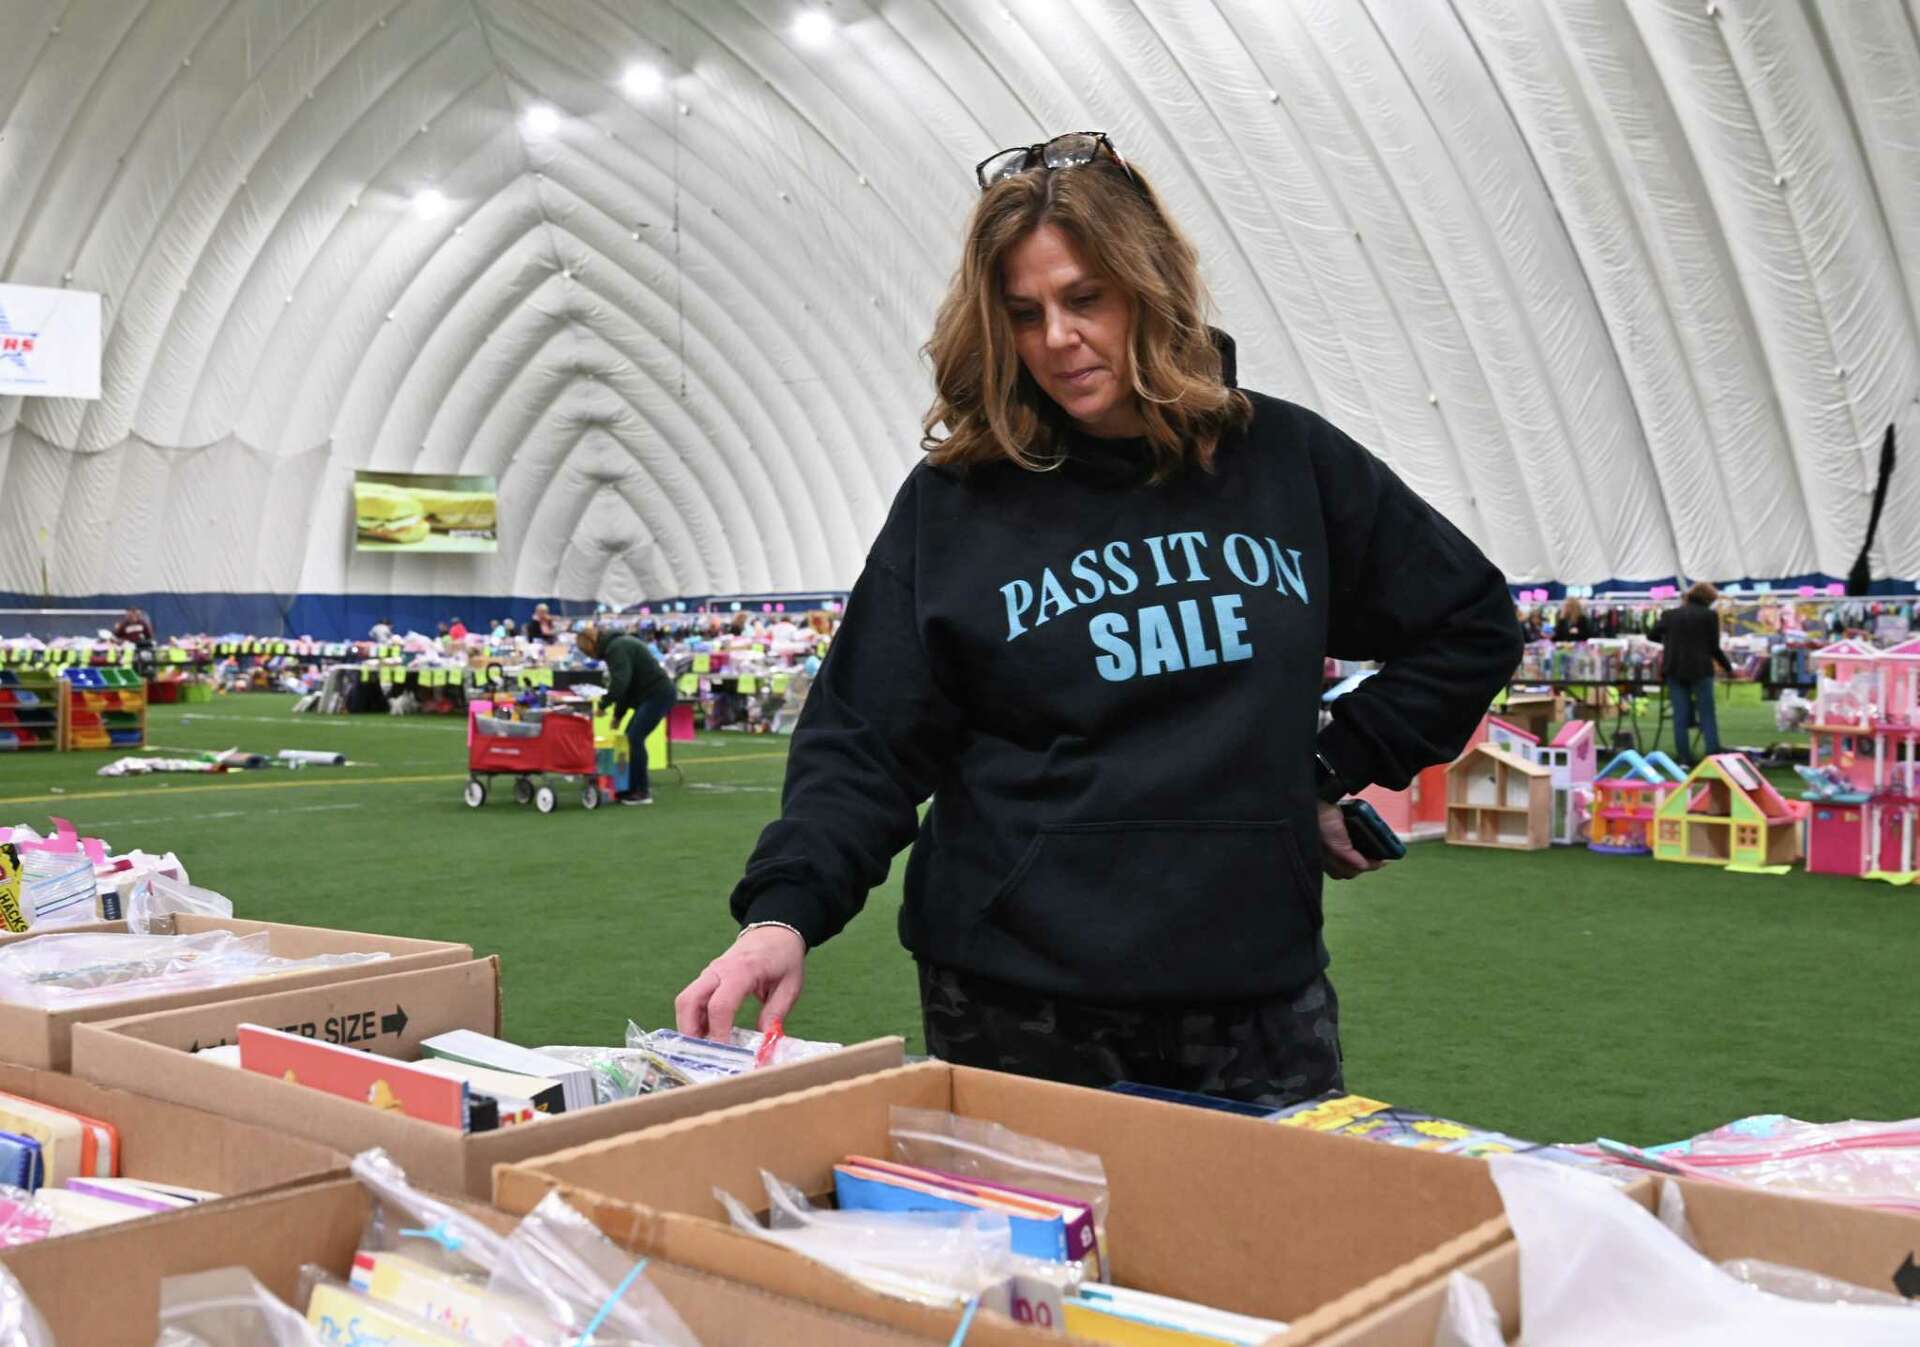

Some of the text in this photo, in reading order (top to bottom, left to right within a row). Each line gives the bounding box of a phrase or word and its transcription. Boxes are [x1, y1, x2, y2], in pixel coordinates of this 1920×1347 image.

[999, 531, 1309, 642] PASS IT ON
[1089, 594, 1253, 682] SALE
[324, 1011, 376, 1045] SIZE
